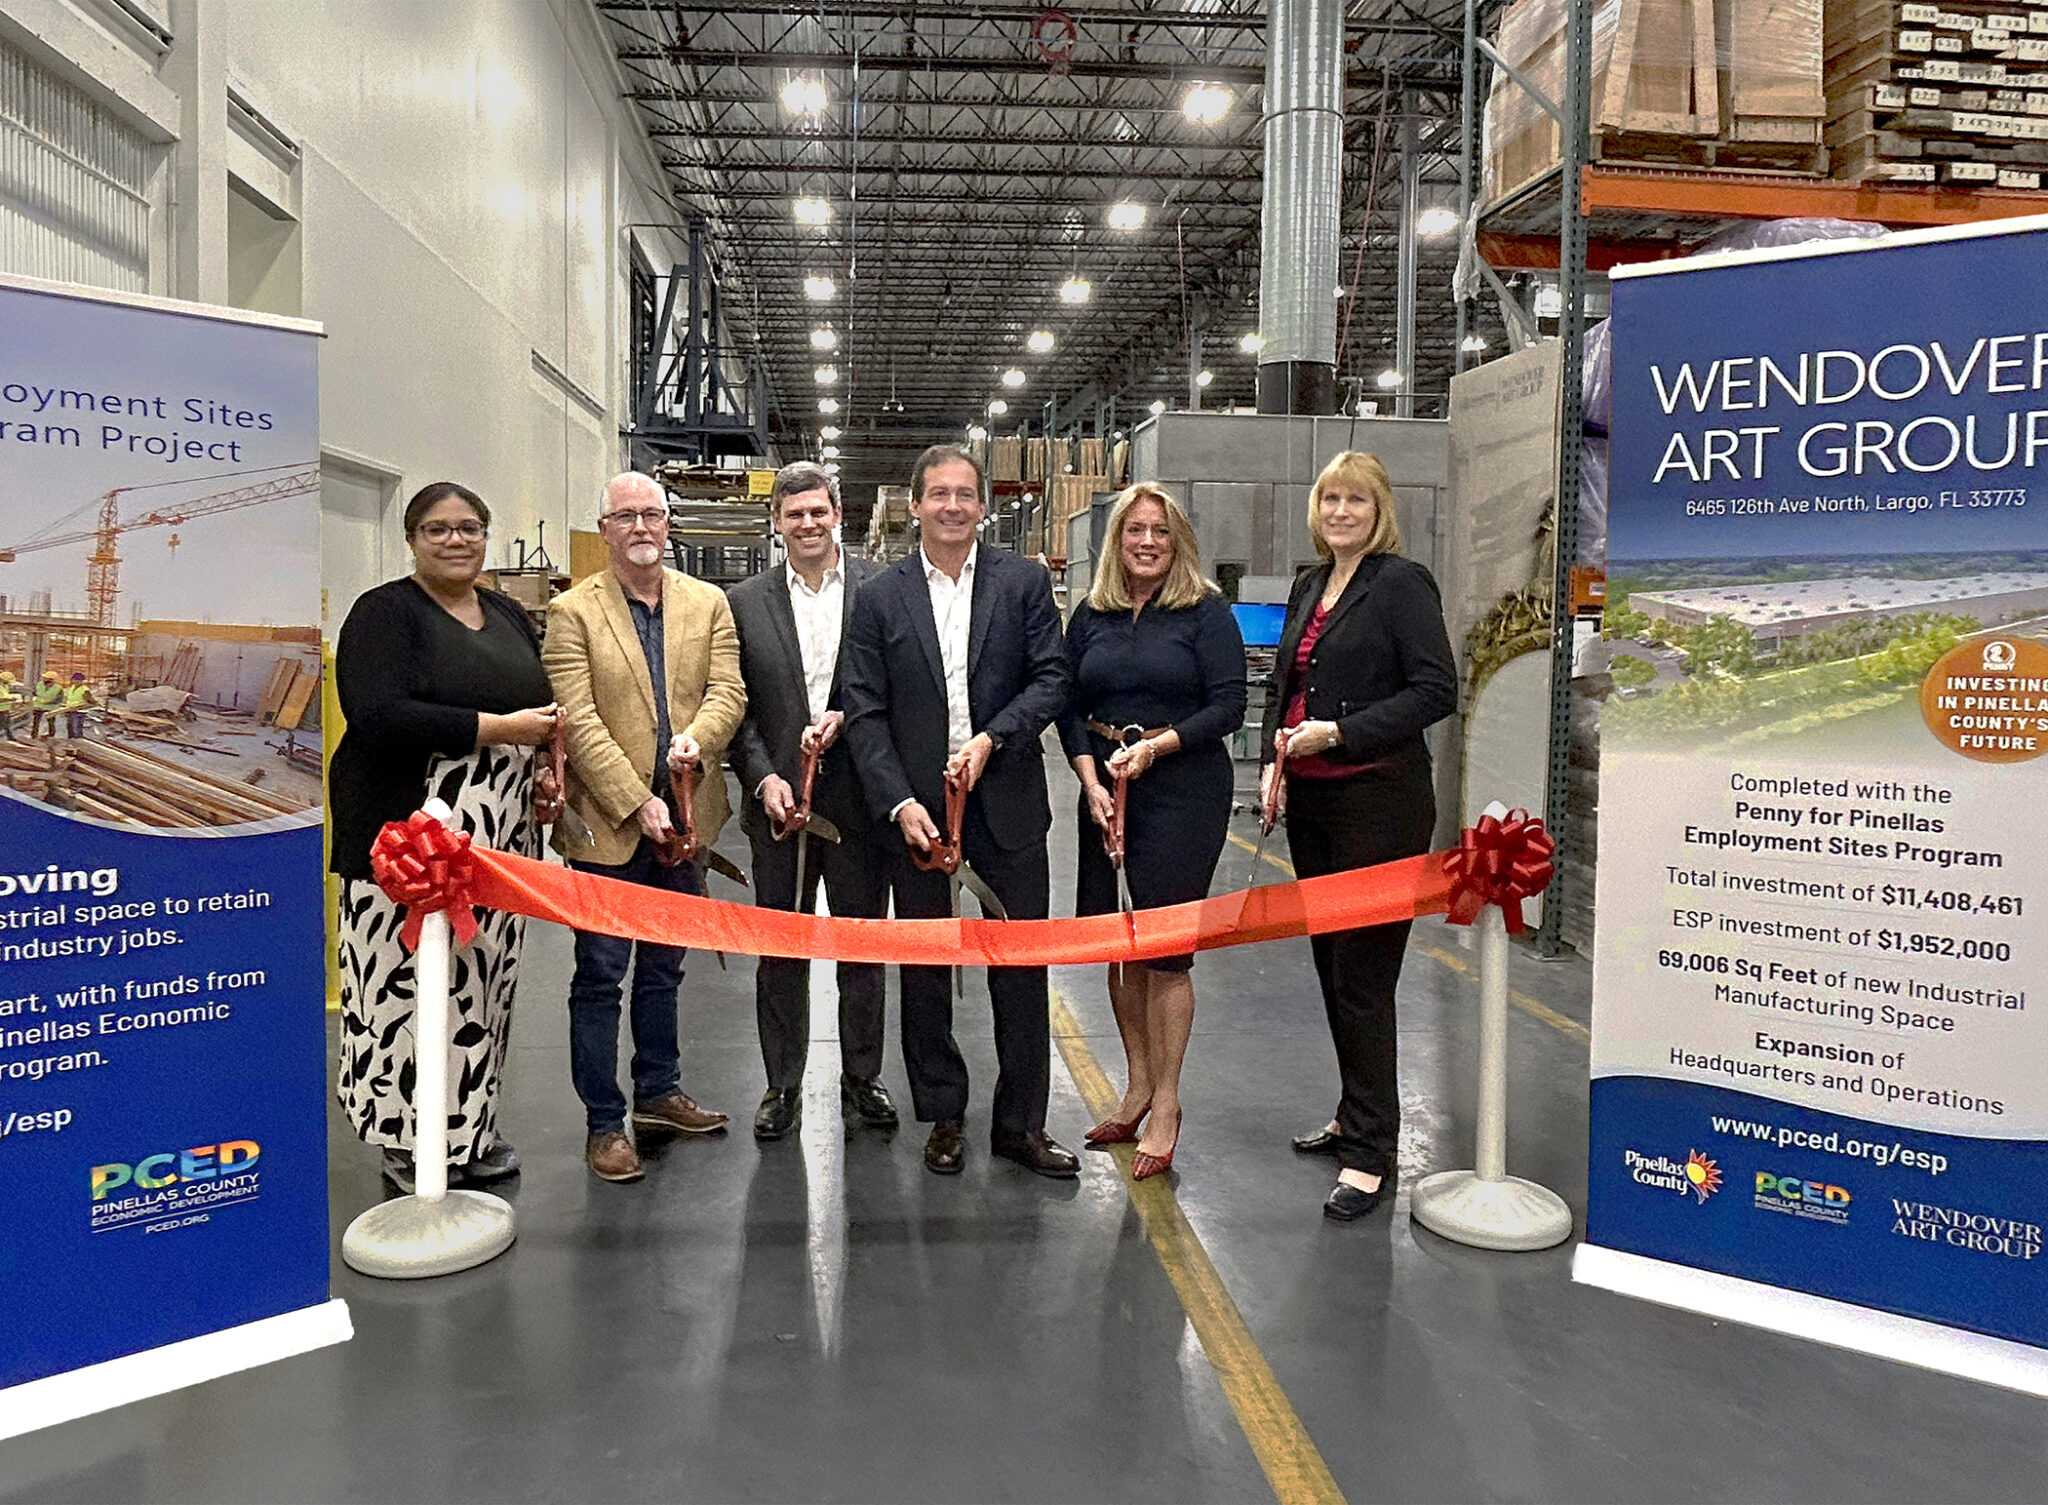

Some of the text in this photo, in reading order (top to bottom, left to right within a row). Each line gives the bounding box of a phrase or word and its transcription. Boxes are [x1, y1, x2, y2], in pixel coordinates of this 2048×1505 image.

[3, 384, 272, 430] oyment Sites
[0, 421, 241, 463] ram Project
[1652, 427, 1780, 483] ART
[1686, 489, 2026, 515] 6465 126th Ave North, Largo, FL 33773
[1938, 696, 1957, 709] IN
[1960, 735, 2037, 750] FUTURE
[1731, 774, 1952, 803] Completed with the
[1735, 802, 1944, 833] Penny for Pinellas
[1684, 826, 2002, 868] Employment Sites Program
[74, 900, 156, 926] space
[164, 895, 190, 915] to
[198, 890, 270, 912] retain
[1666, 867, 2024, 916] Total investment of $11,408,461
[120, 928, 183, 954] jobs.
[1673, 910, 2011, 961] ESP investment of $1,952,000
[56, 986, 116, 1009] with
[125, 976, 199, 1000] funds
[207, 970, 266, 990] from
[1658, 950, 2026, 1010] 69,006 Sq Feet of new Industrial
[0, 1001, 230, 1049] inellas Economic
[1715, 984, 1954, 1032] Manufacturing Space
[1755, 1031, 1905, 1069] Expansion of
[1670, 1047, 2004, 1115] Headquarters and Operations
[0, 1109, 72, 1138] /esp
[1624, 1149, 1683, 1175] Pinellas
[1711, 1116, 1948, 1175] www.pced.org/esp
[91, 1140, 260, 1200] PCED
[1633, 1168, 1688, 1195] County
[1755, 1171, 1851, 1208] PCED
[92, 1173, 259, 1216] PINELLAS COUNTY
[92, 1184, 259, 1227] ECONOMIC DEVELOPMENT
[145, 1213, 210, 1234] PCED.ORG
[1891, 1218, 2041, 1261] ART GROUP
[1892, 1198, 2042, 1244] WENDOVER
